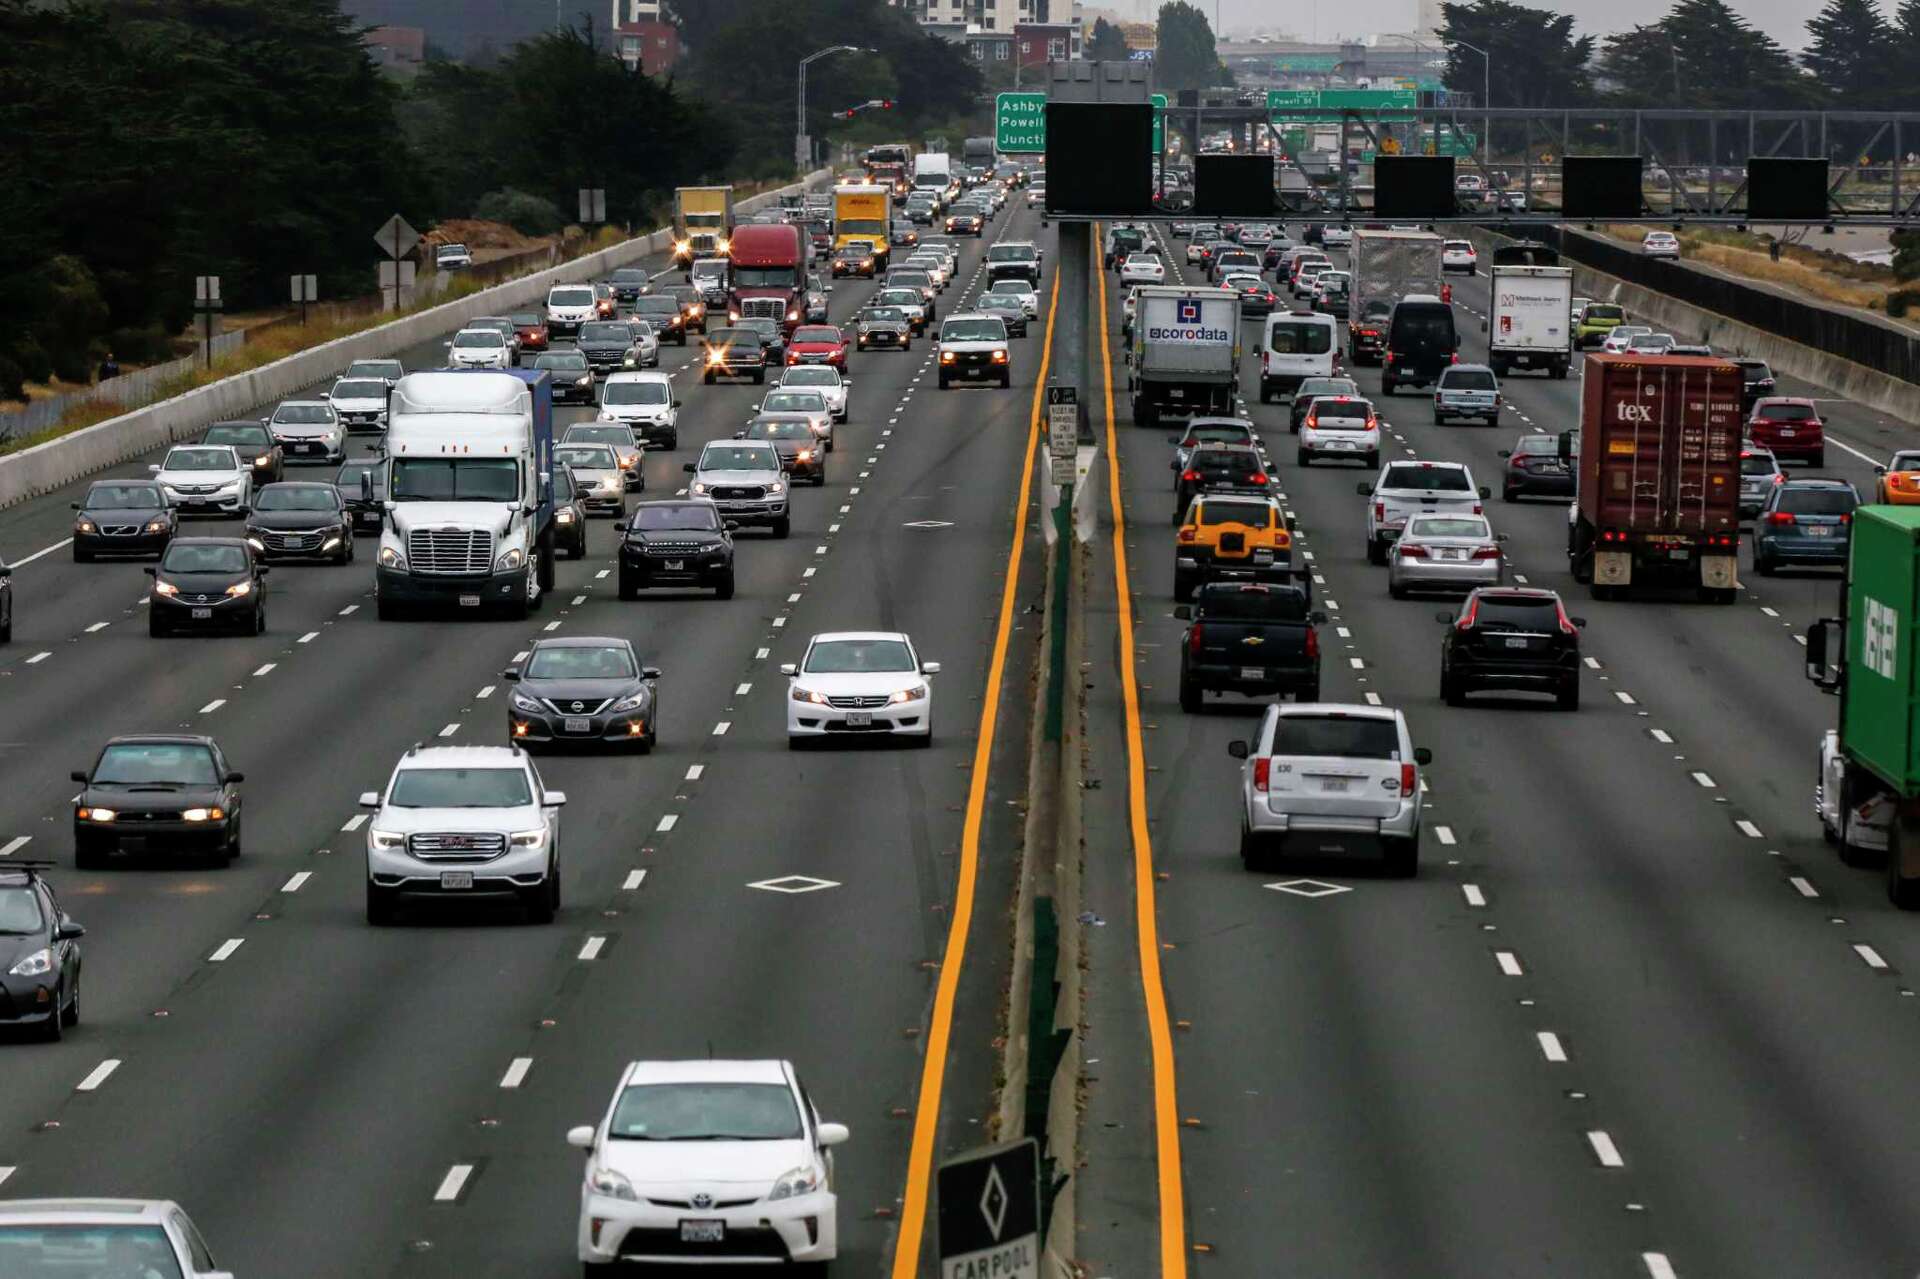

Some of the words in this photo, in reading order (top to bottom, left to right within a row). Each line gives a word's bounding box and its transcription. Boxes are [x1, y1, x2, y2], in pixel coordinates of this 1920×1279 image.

[1001, 100, 1044, 113] Ashby
[1000, 116, 1044, 128] Powell
[1001, 133, 1045, 145] Juncti
[1161, 327, 1228, 340] corodata
[1616, 399, 1652, 422] tex
[952, 1244, 1031, 1279] CARPOOL
